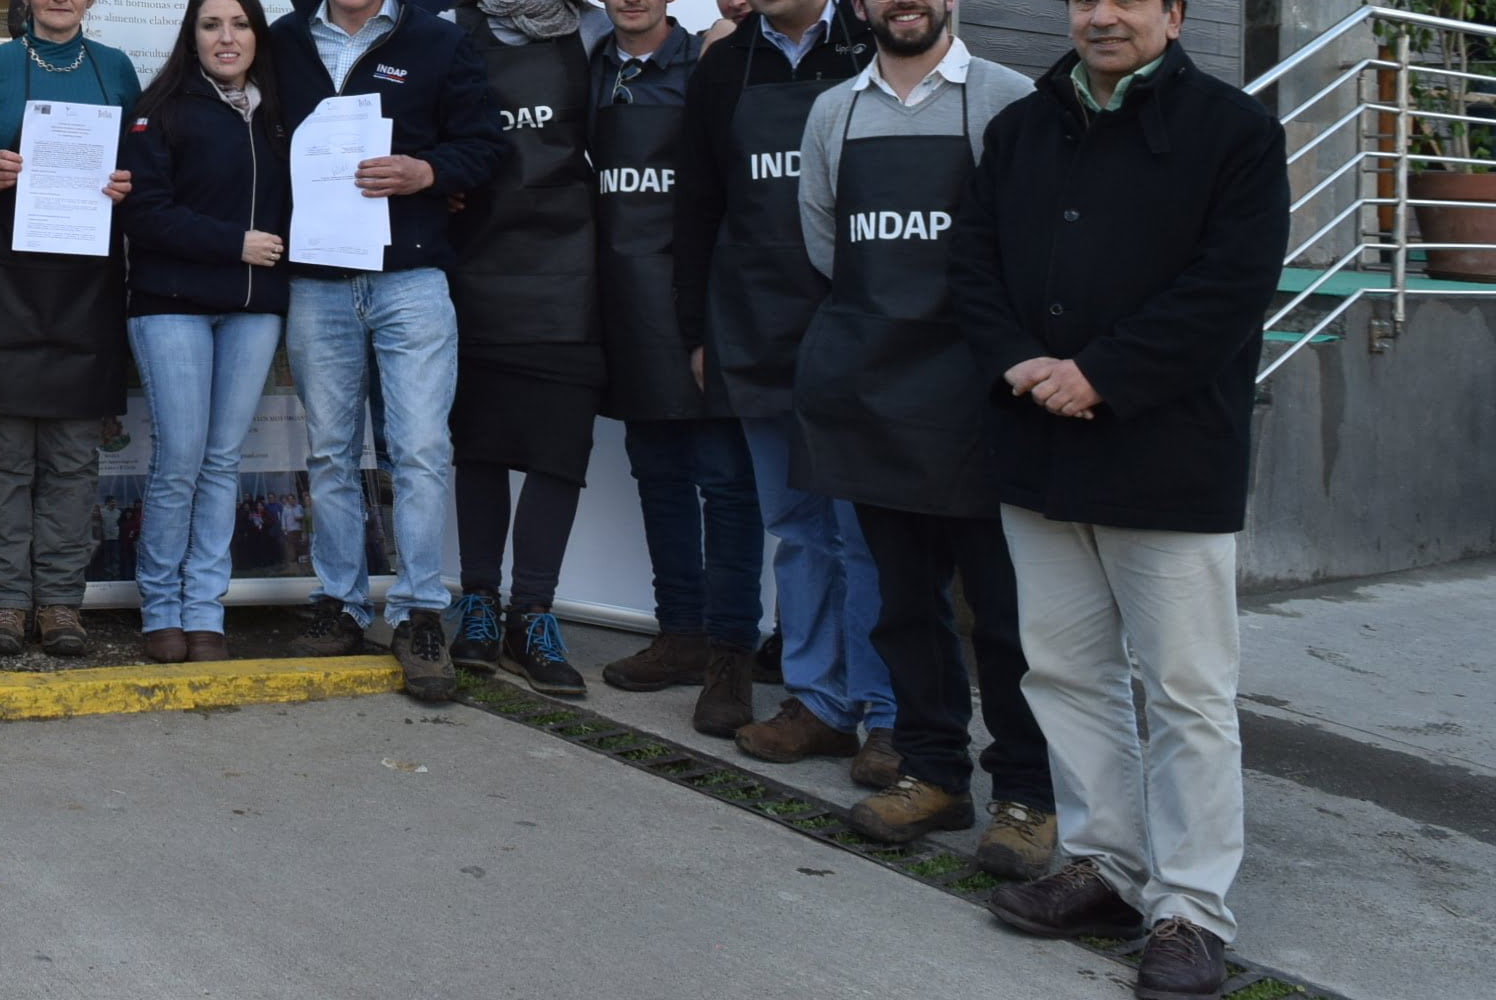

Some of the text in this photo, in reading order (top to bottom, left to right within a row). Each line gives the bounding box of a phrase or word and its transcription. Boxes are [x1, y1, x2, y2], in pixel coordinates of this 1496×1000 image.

[104, 12, 147, 24] alimentos
[376, 63, 408, 77] INDAP
[850, 210, 952, 242] INDAP
